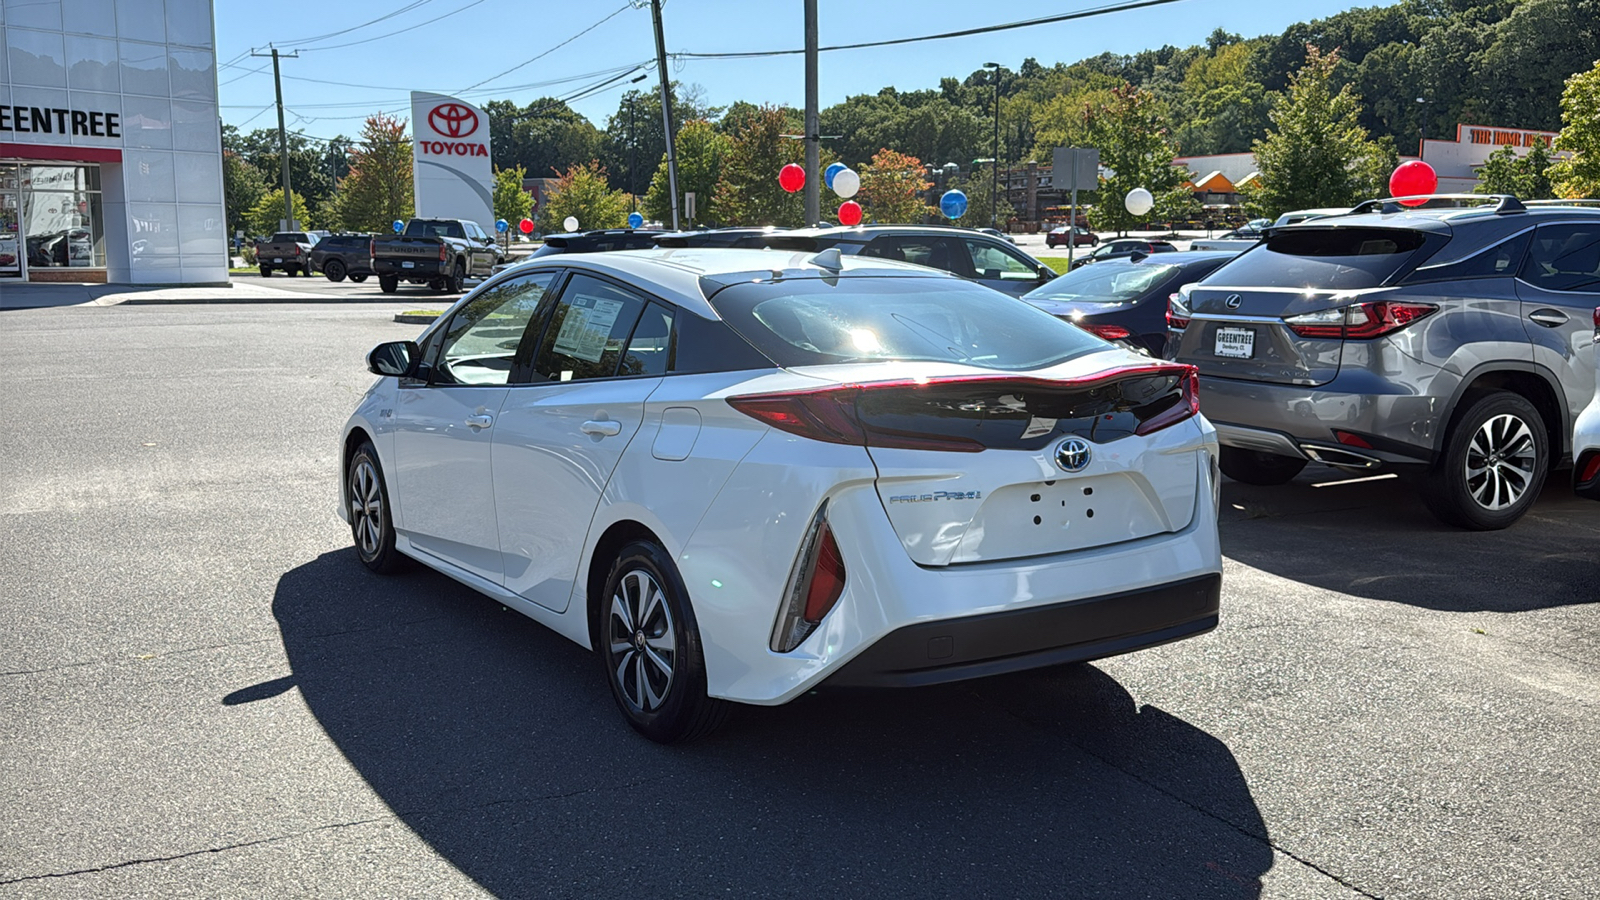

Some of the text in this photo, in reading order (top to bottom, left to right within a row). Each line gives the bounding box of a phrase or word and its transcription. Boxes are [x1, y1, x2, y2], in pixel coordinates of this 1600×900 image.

[0, 105, 121, 138] EENTREE
[1470, 128, 1553, 149] THE HOME DEOT
[419, 141, 488, 157] TOYOTA
[388, 246, 427, 254] TUNDRA
[1217, 332, 1252, 345] GREENTREE
